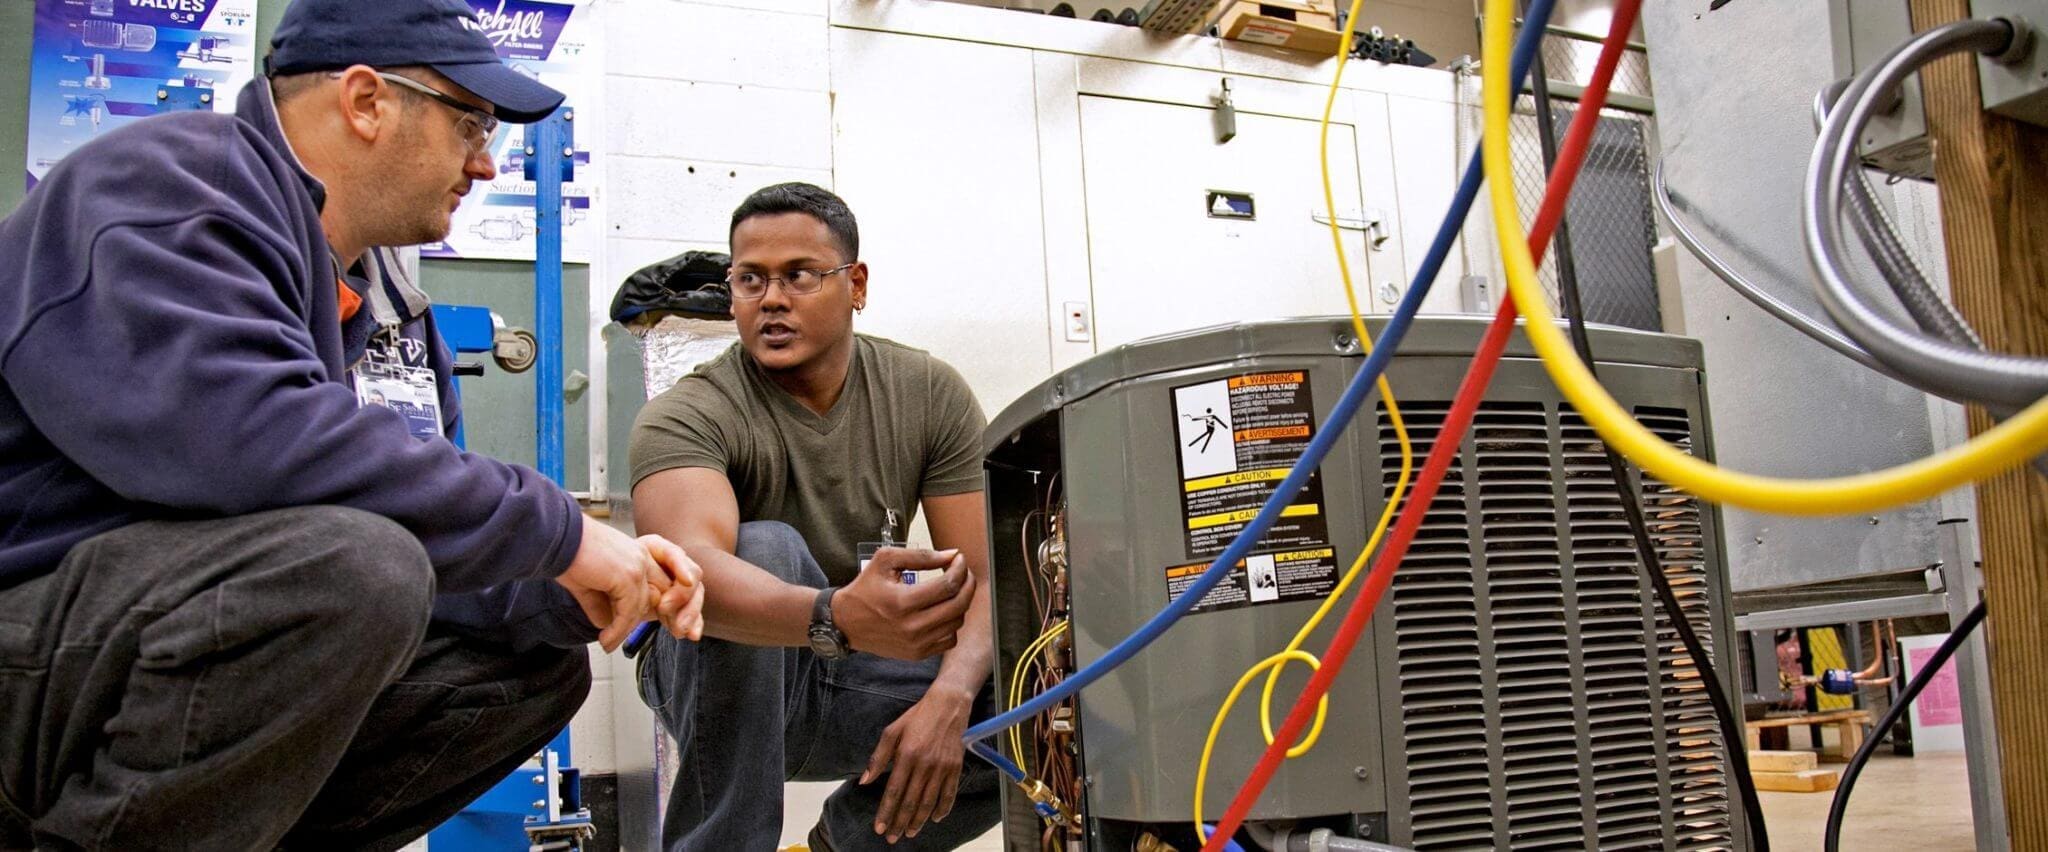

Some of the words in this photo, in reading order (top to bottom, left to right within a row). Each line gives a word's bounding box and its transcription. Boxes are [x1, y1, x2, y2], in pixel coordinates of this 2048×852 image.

[129, 0, 205, 12] VALVES
[1250, 373, 1295, 384] WARNING
[1230, 385, 1268, 395] HAZARDOUS
[1268, 383, 1299, 392] VOLTAGE!
[1248, 427, 1305, 439] AVERTISSEMENT
[1235, 471, 1271, 482] CAUTION
[1291, 550, 1324, 560] CAUTION
